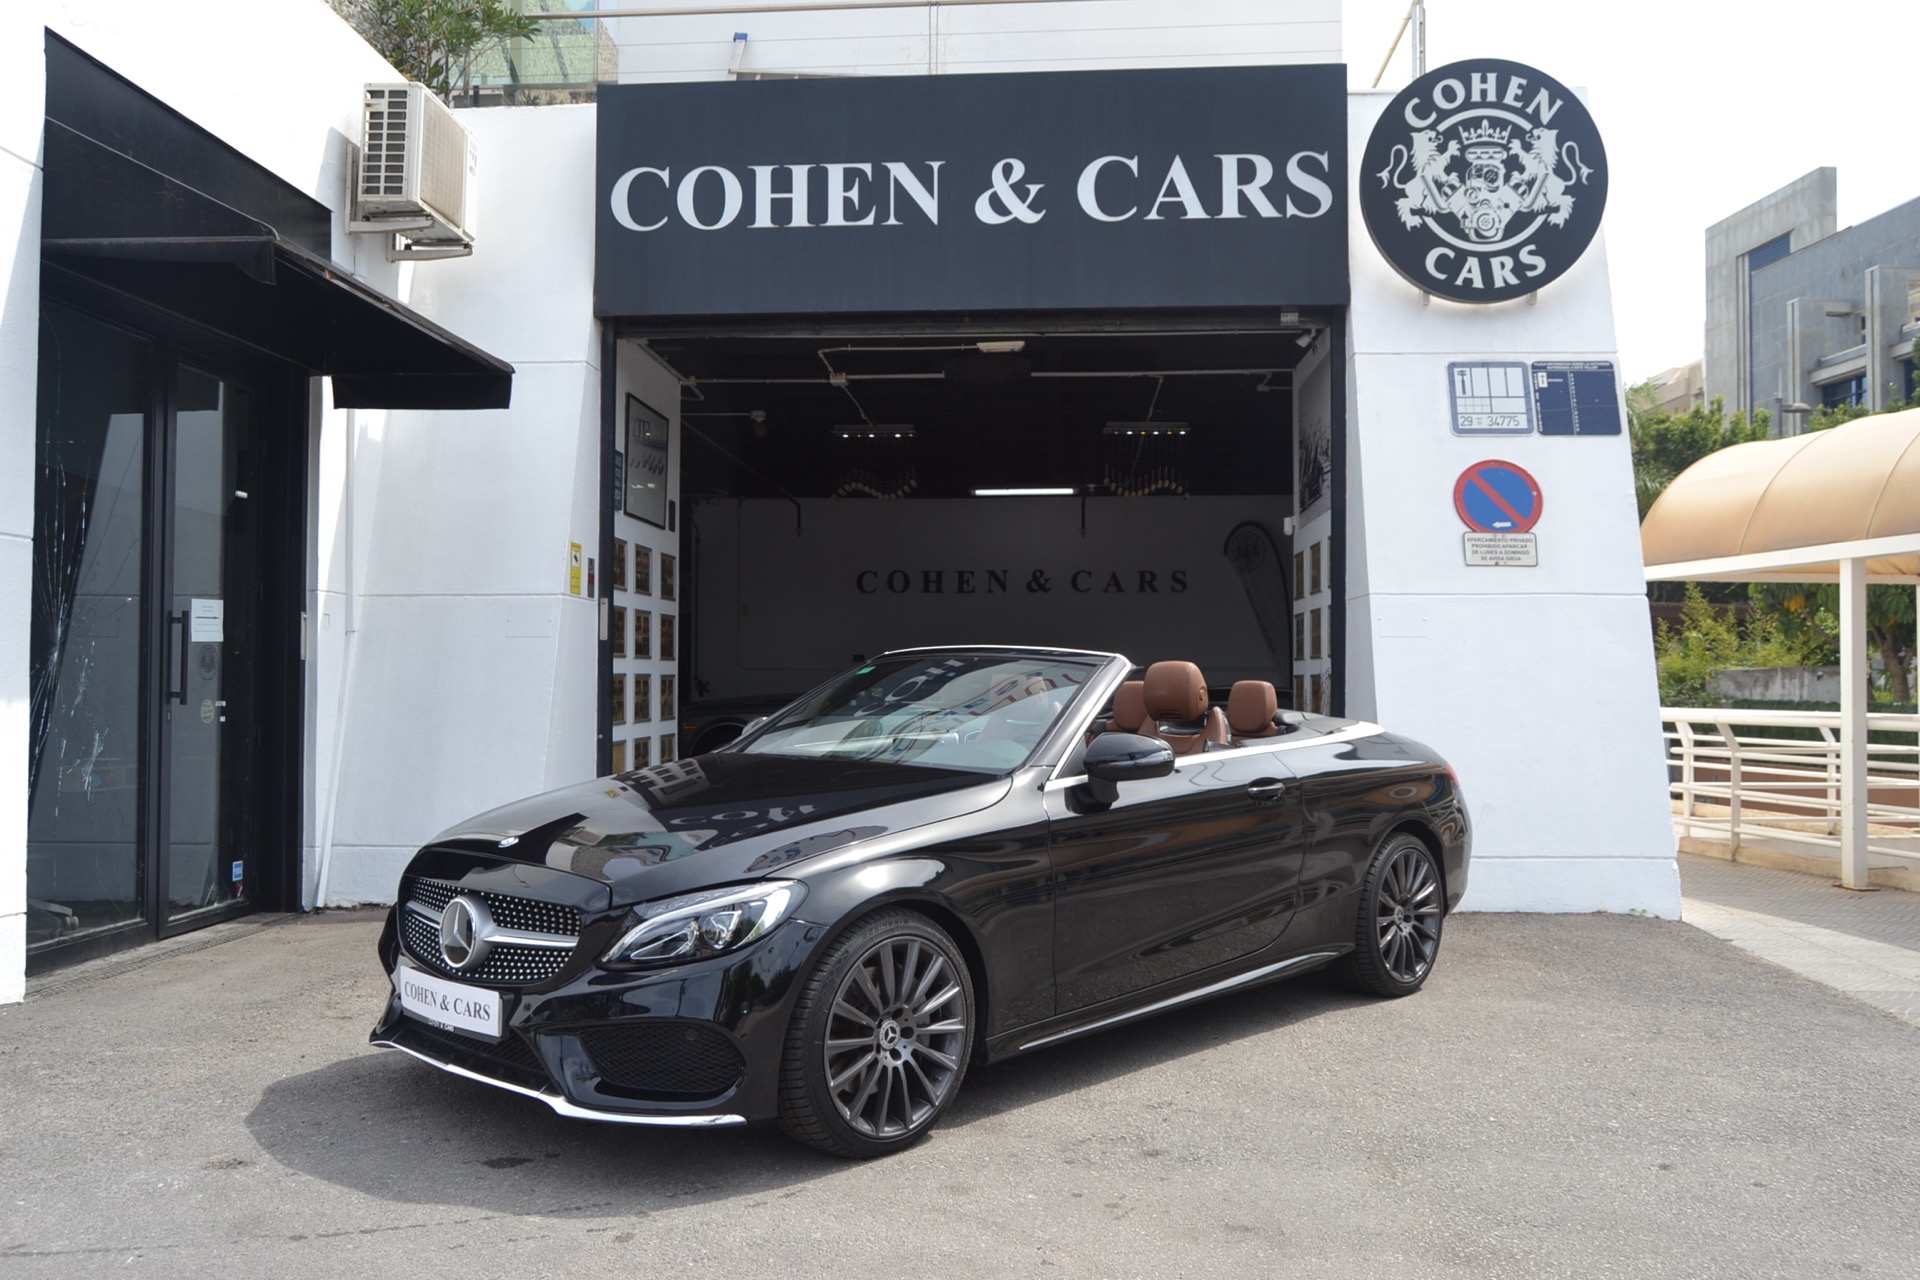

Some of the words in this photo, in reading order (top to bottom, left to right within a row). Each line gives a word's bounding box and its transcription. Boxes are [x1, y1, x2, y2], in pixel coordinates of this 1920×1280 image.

[1404, 72, 1564, 128] COHEN
[610, 160, 946, 231] COHEN
[974, 157, 1047, 225] &
[1076, 150, 1333, 222] CARS
[1425, 244, 1547, 289] CARS
[1460, 415, 1473, 427] 29
[1487, 415, 1520, 427] 34775
[855, 569, 1009, 594] COHEN
[1025, 569, 1052, 594] &
[1070, 569, 1188, 594] CARS
[404, 980, 438, 1008] COHEN
[439, 994, 450, 1012] &
[453, 997, 491, 1022] CARS
